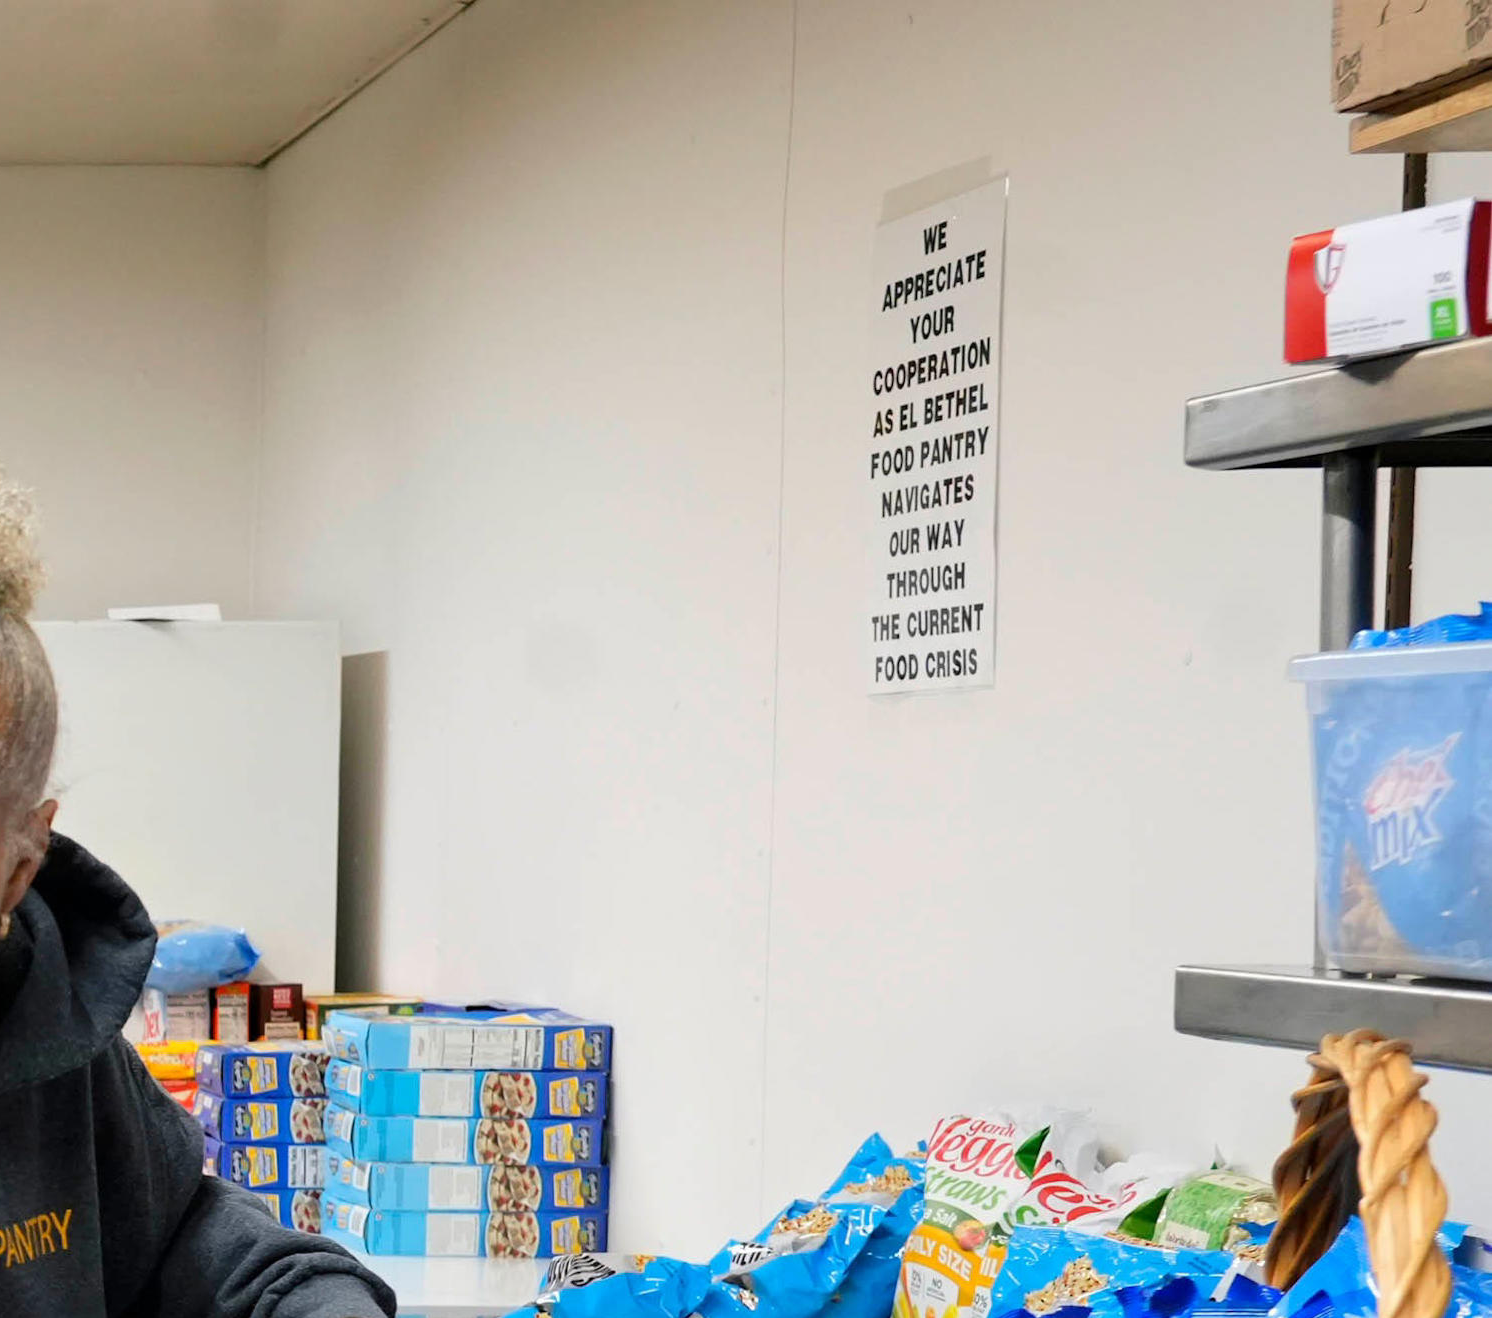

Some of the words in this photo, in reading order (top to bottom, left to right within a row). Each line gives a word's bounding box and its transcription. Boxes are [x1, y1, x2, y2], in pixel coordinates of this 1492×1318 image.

[923, 221, 948, 255] WE
[882, 250, 987, 312] APPRECIATE
[910, 305, 955, 344] YOUR
[873, 337, 991, 396] COOPERATION
[873, 407, 894, 437] AS
[900, 403, 918, 432] EL
[923, 383, 989, 426] BETHEL
[871, 445, 914, 479] FOOD
[920, 426, 990, 470] PANTRY
[882, 474, 974, 518] NAVIGATES
[889, 526, 920, 557] OUR
[927, 519, 965, 551] WAY
[887, 562, 965, 600] THROUGH
[871, 614, 900, 642] THE
[907, 603, 984, 638] CURRENT
[875, 654, 919, 683] FOOD
[925, 648, 978, 680] CRISIS
[966, 1119, 1016, 1138] gard
[932, 1207, 959, 1228] Salt
[937, 1247, 973, 1282] SIZE
